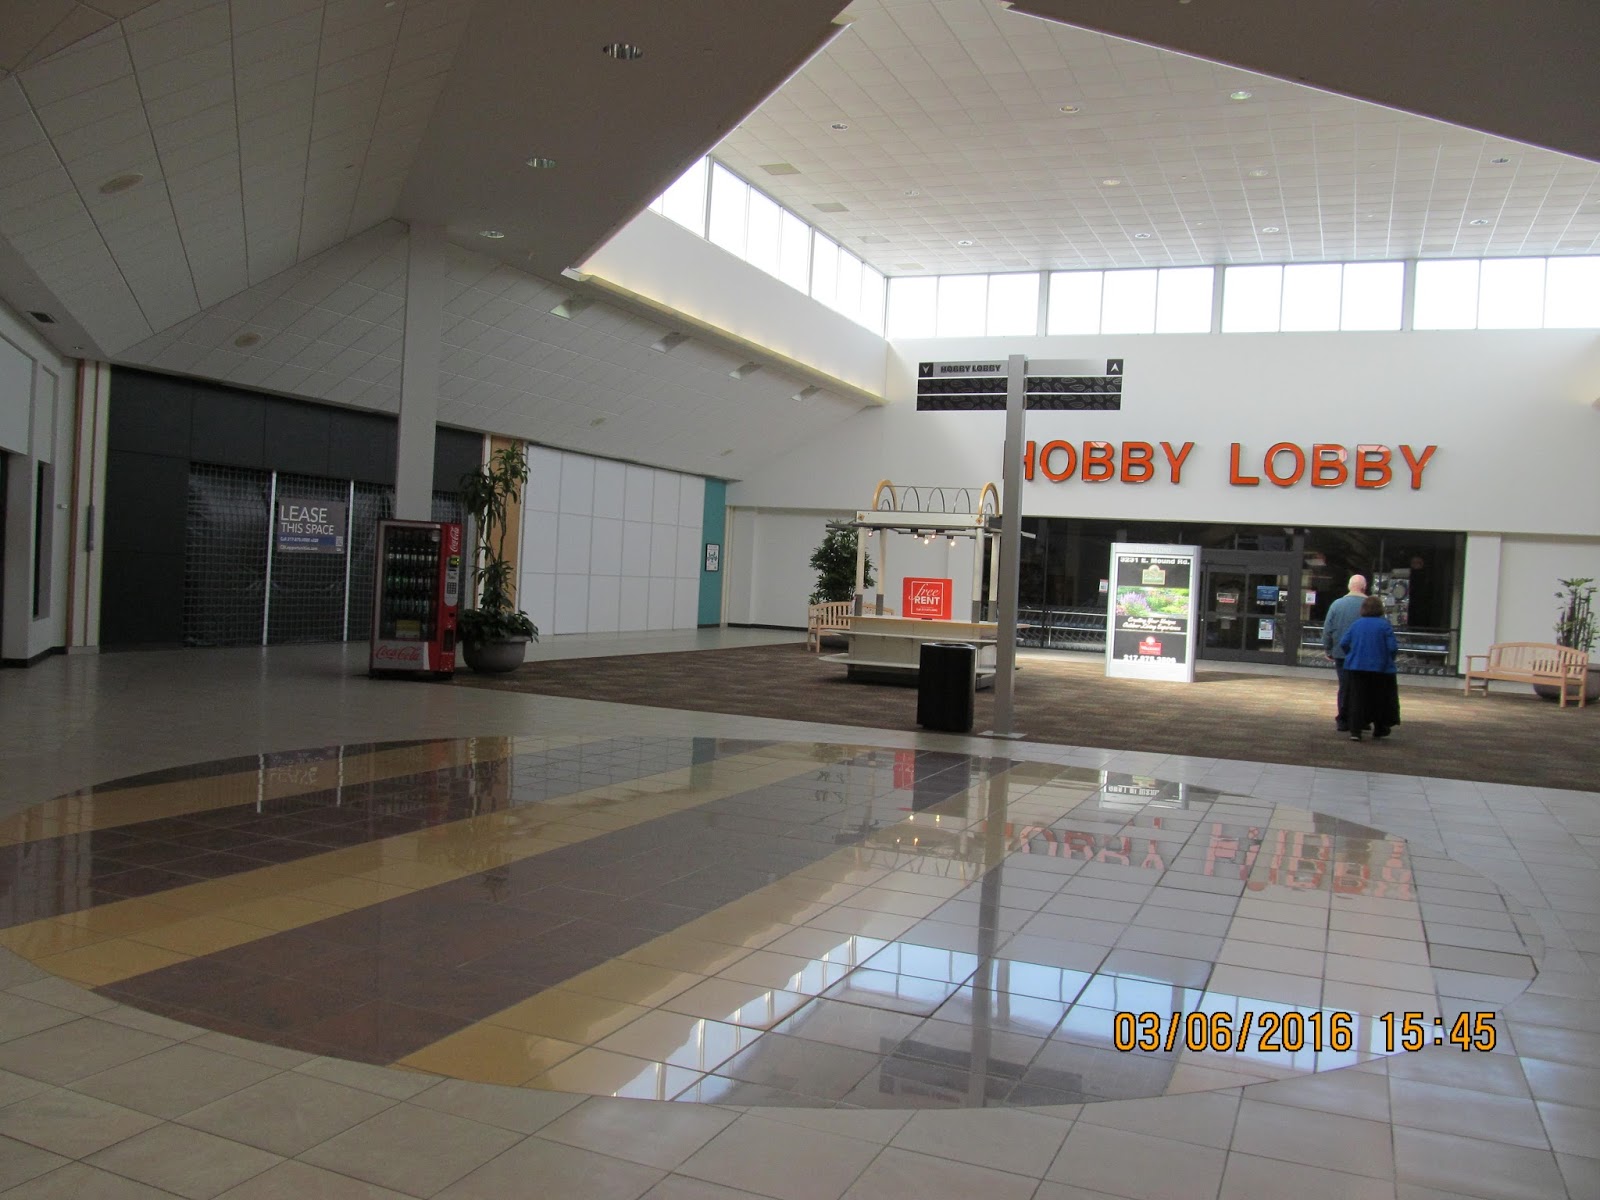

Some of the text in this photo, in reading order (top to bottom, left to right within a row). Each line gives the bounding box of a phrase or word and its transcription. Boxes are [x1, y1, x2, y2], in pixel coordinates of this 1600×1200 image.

[940, 363, 1002, 374] HOBBY LOBBY
[1229, 441, 1438, 490] LOBBY
[281, 505, 328, 523] LEASE
[281, 522, 335, 535] THIS SPACE
[911, 583, 939, 598] free
[914, 596, 940, 605] RENT
